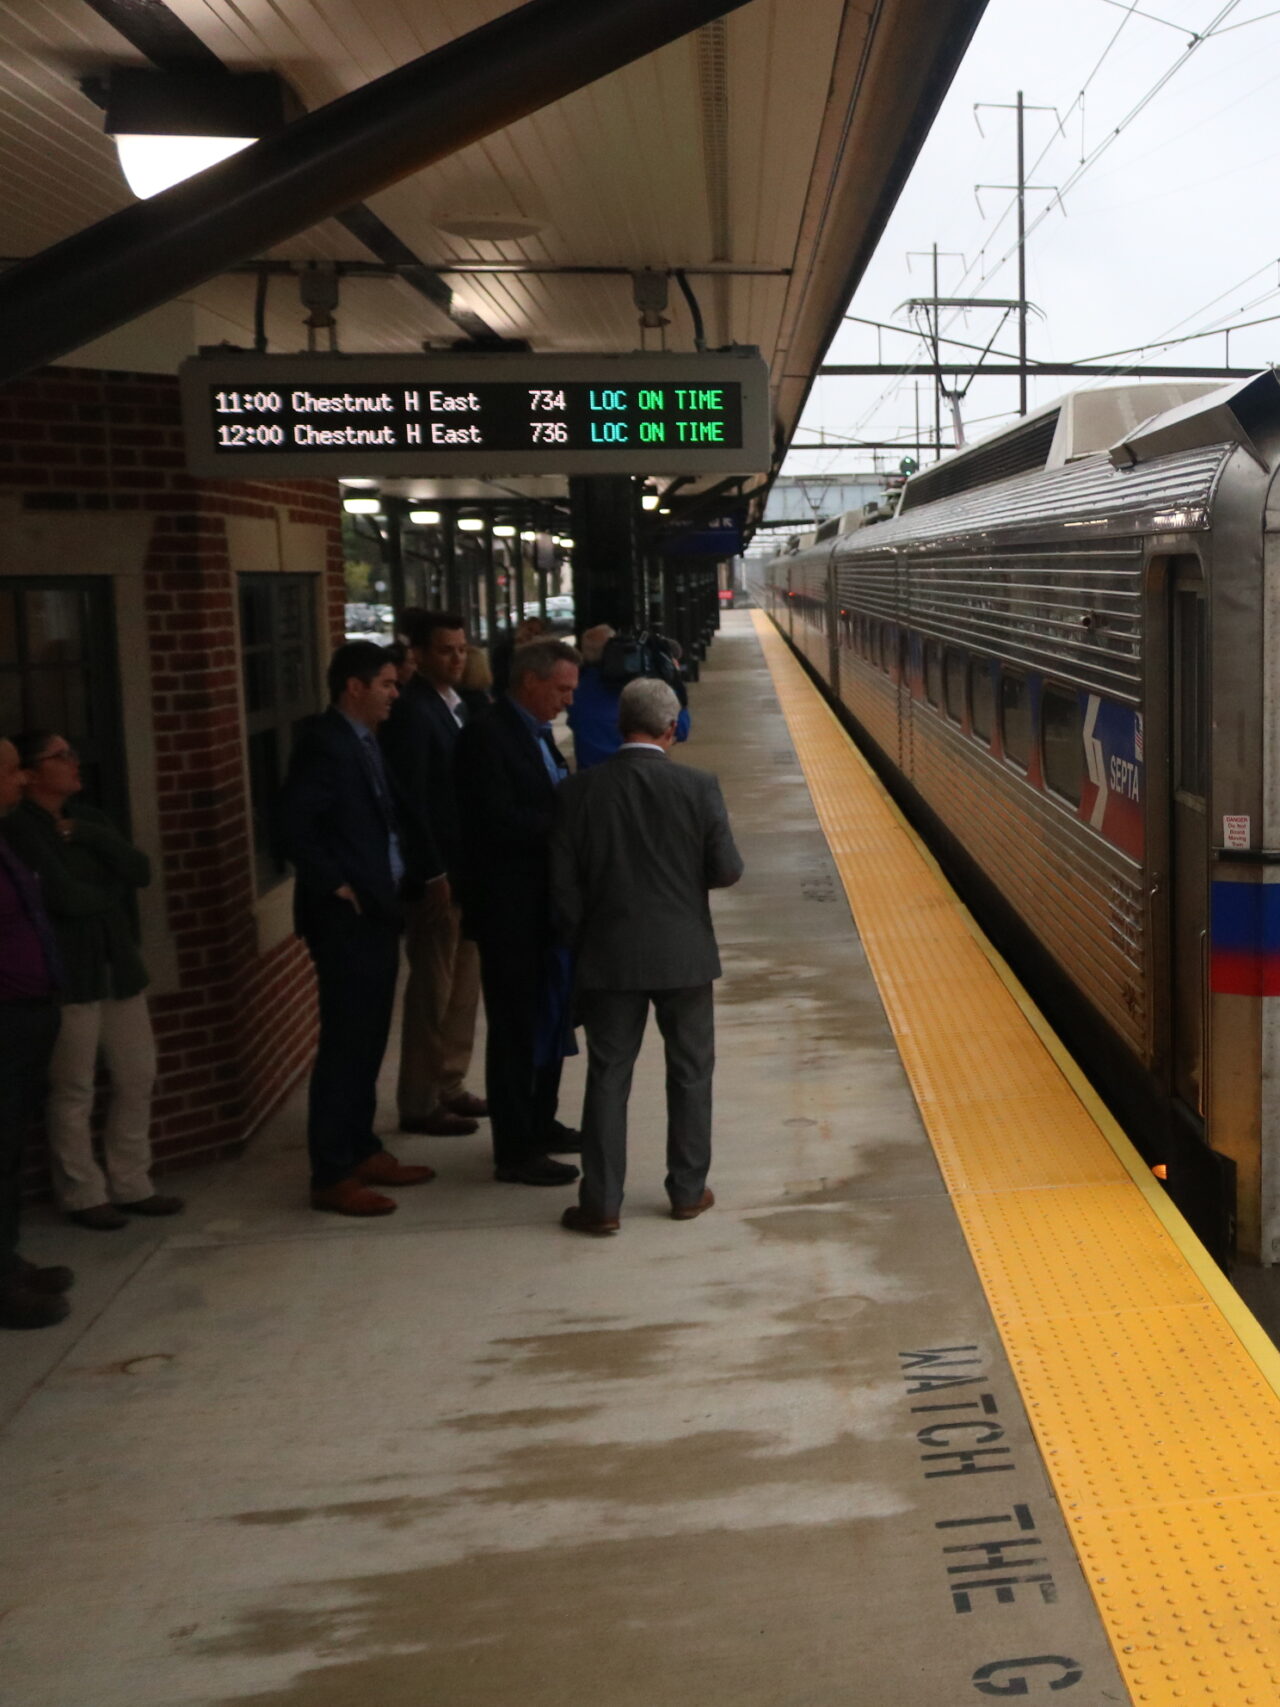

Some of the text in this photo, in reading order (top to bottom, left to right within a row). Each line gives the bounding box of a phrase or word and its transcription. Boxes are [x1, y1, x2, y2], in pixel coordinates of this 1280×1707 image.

[216, 389, 724, 413] 11:00 Chestnut H East 734 LOC ON TIME
[218, 422, 725, 446] 12:00 Chestnut H East 736 LOC ON TIME
[1110, 755, 1139, 803] SEPTA
[898, 1345, 1016, 1479] WATCH
[935, 1504, 1058, 1614] THE
